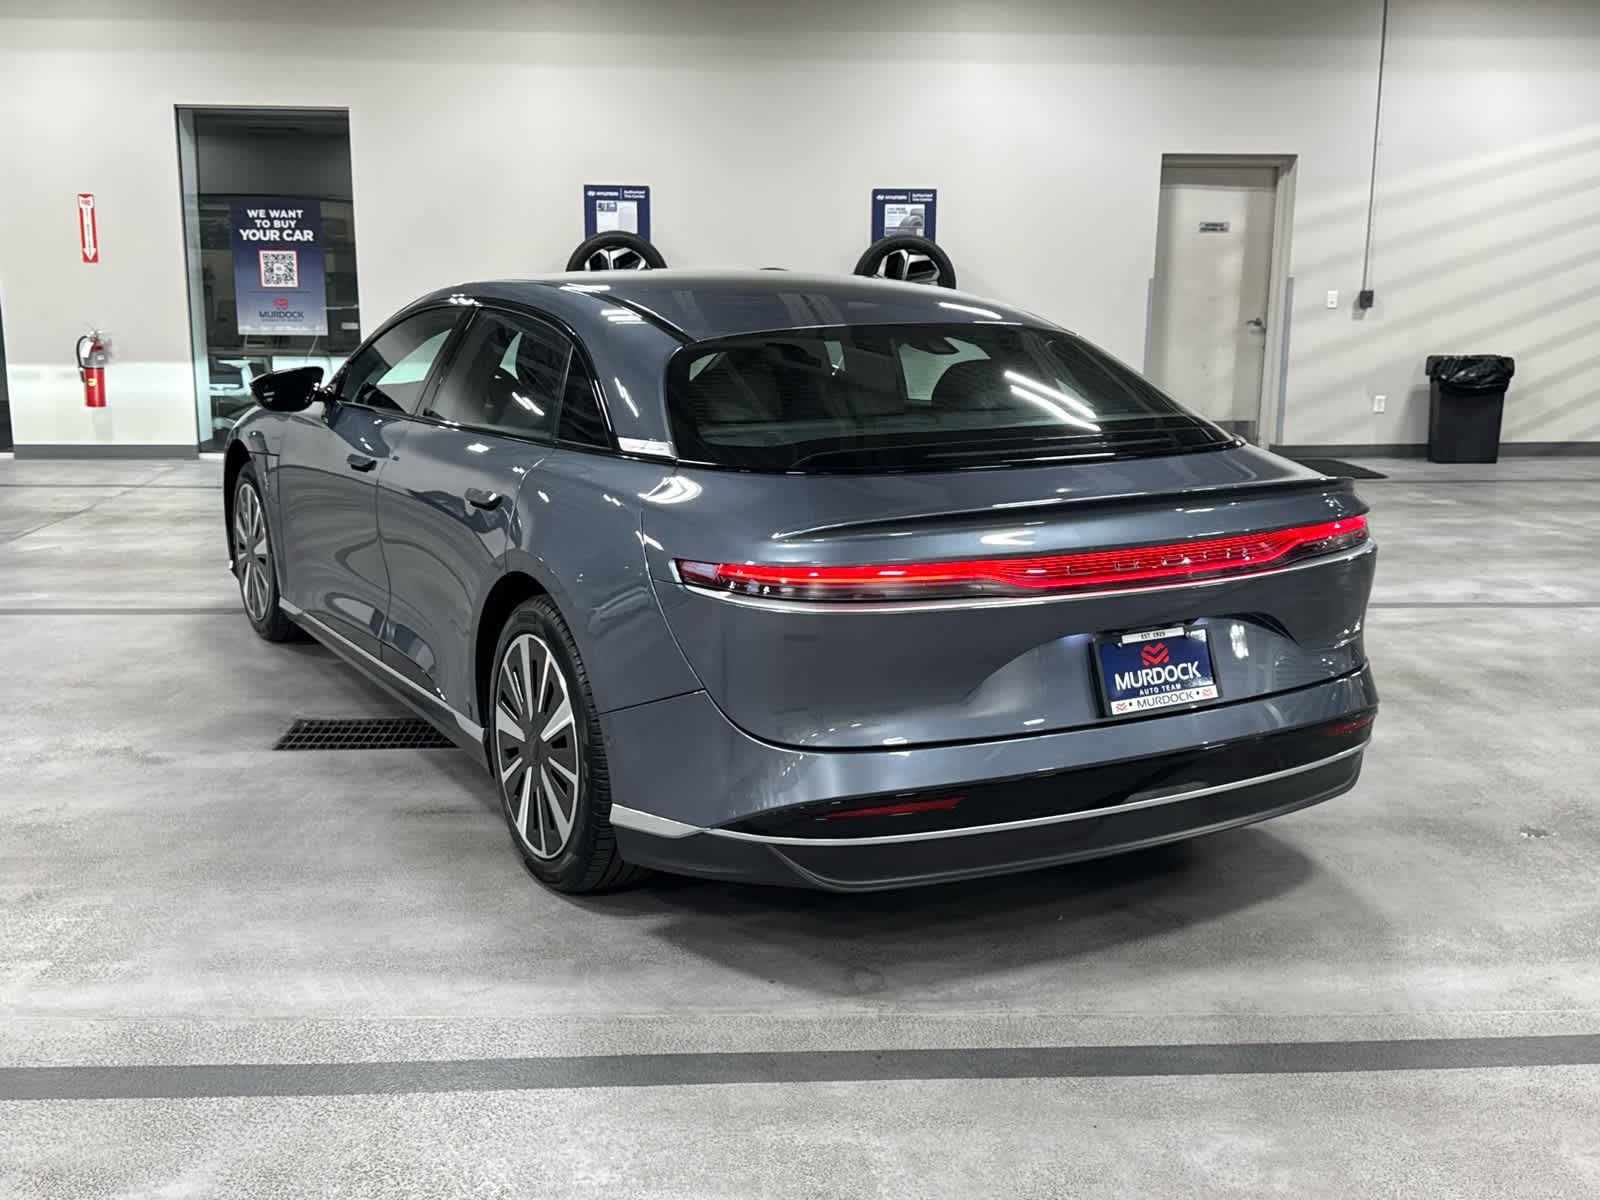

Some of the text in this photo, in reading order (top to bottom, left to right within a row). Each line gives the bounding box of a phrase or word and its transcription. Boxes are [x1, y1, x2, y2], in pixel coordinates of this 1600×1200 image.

[247, 209, 304, 219] WE WANT
[254, 219, 297, 229] TO BUY
[239, 229, 314, 242] YOUR CAR
[1114, 661, 1202, 691] MURDOCK
[1139, 683, 1182, 696] AUTO TEAM
[1136, 691, 1195, 709] MURDOCK
